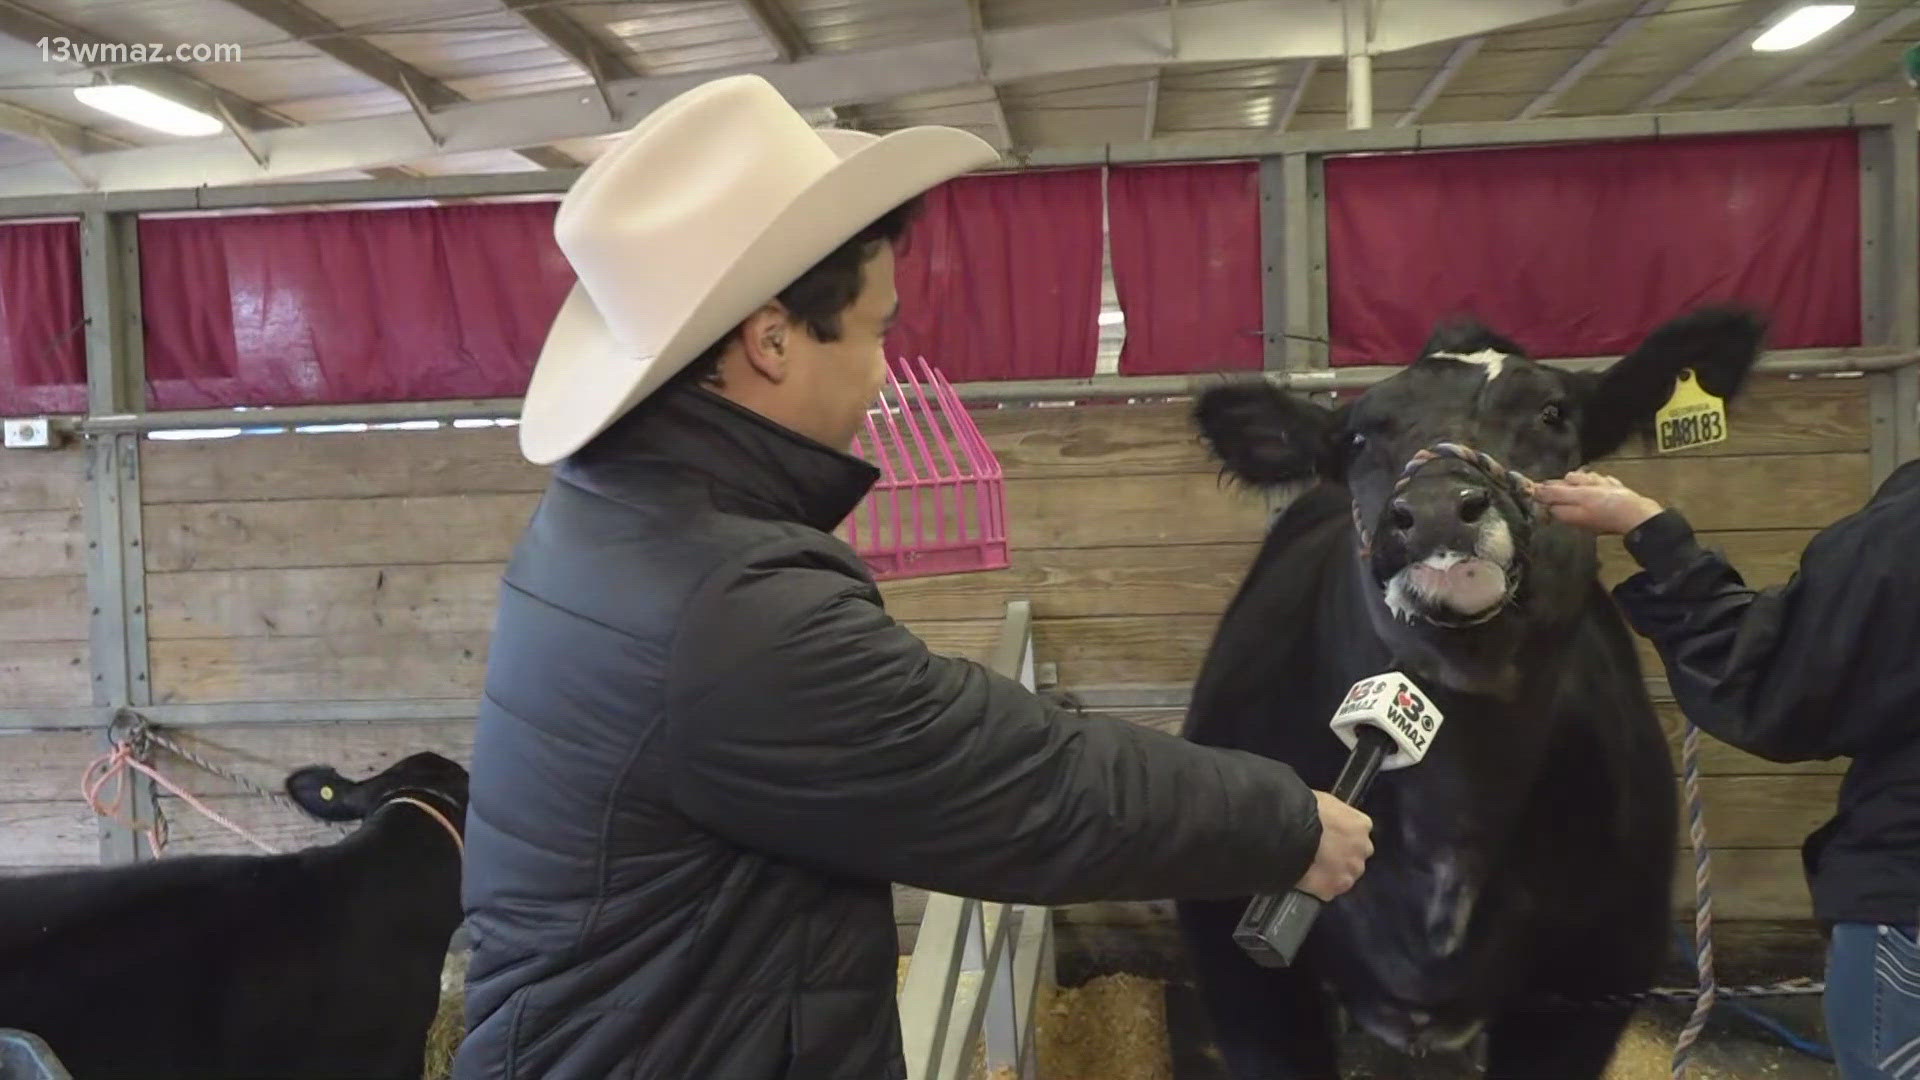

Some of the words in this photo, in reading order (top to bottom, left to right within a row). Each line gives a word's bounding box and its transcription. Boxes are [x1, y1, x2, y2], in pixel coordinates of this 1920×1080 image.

[1661, 411, 1722, 449] GA8183
[1393, 682, 1424, 722] 13
[1387, 705, 1426, 751] WMAZ
